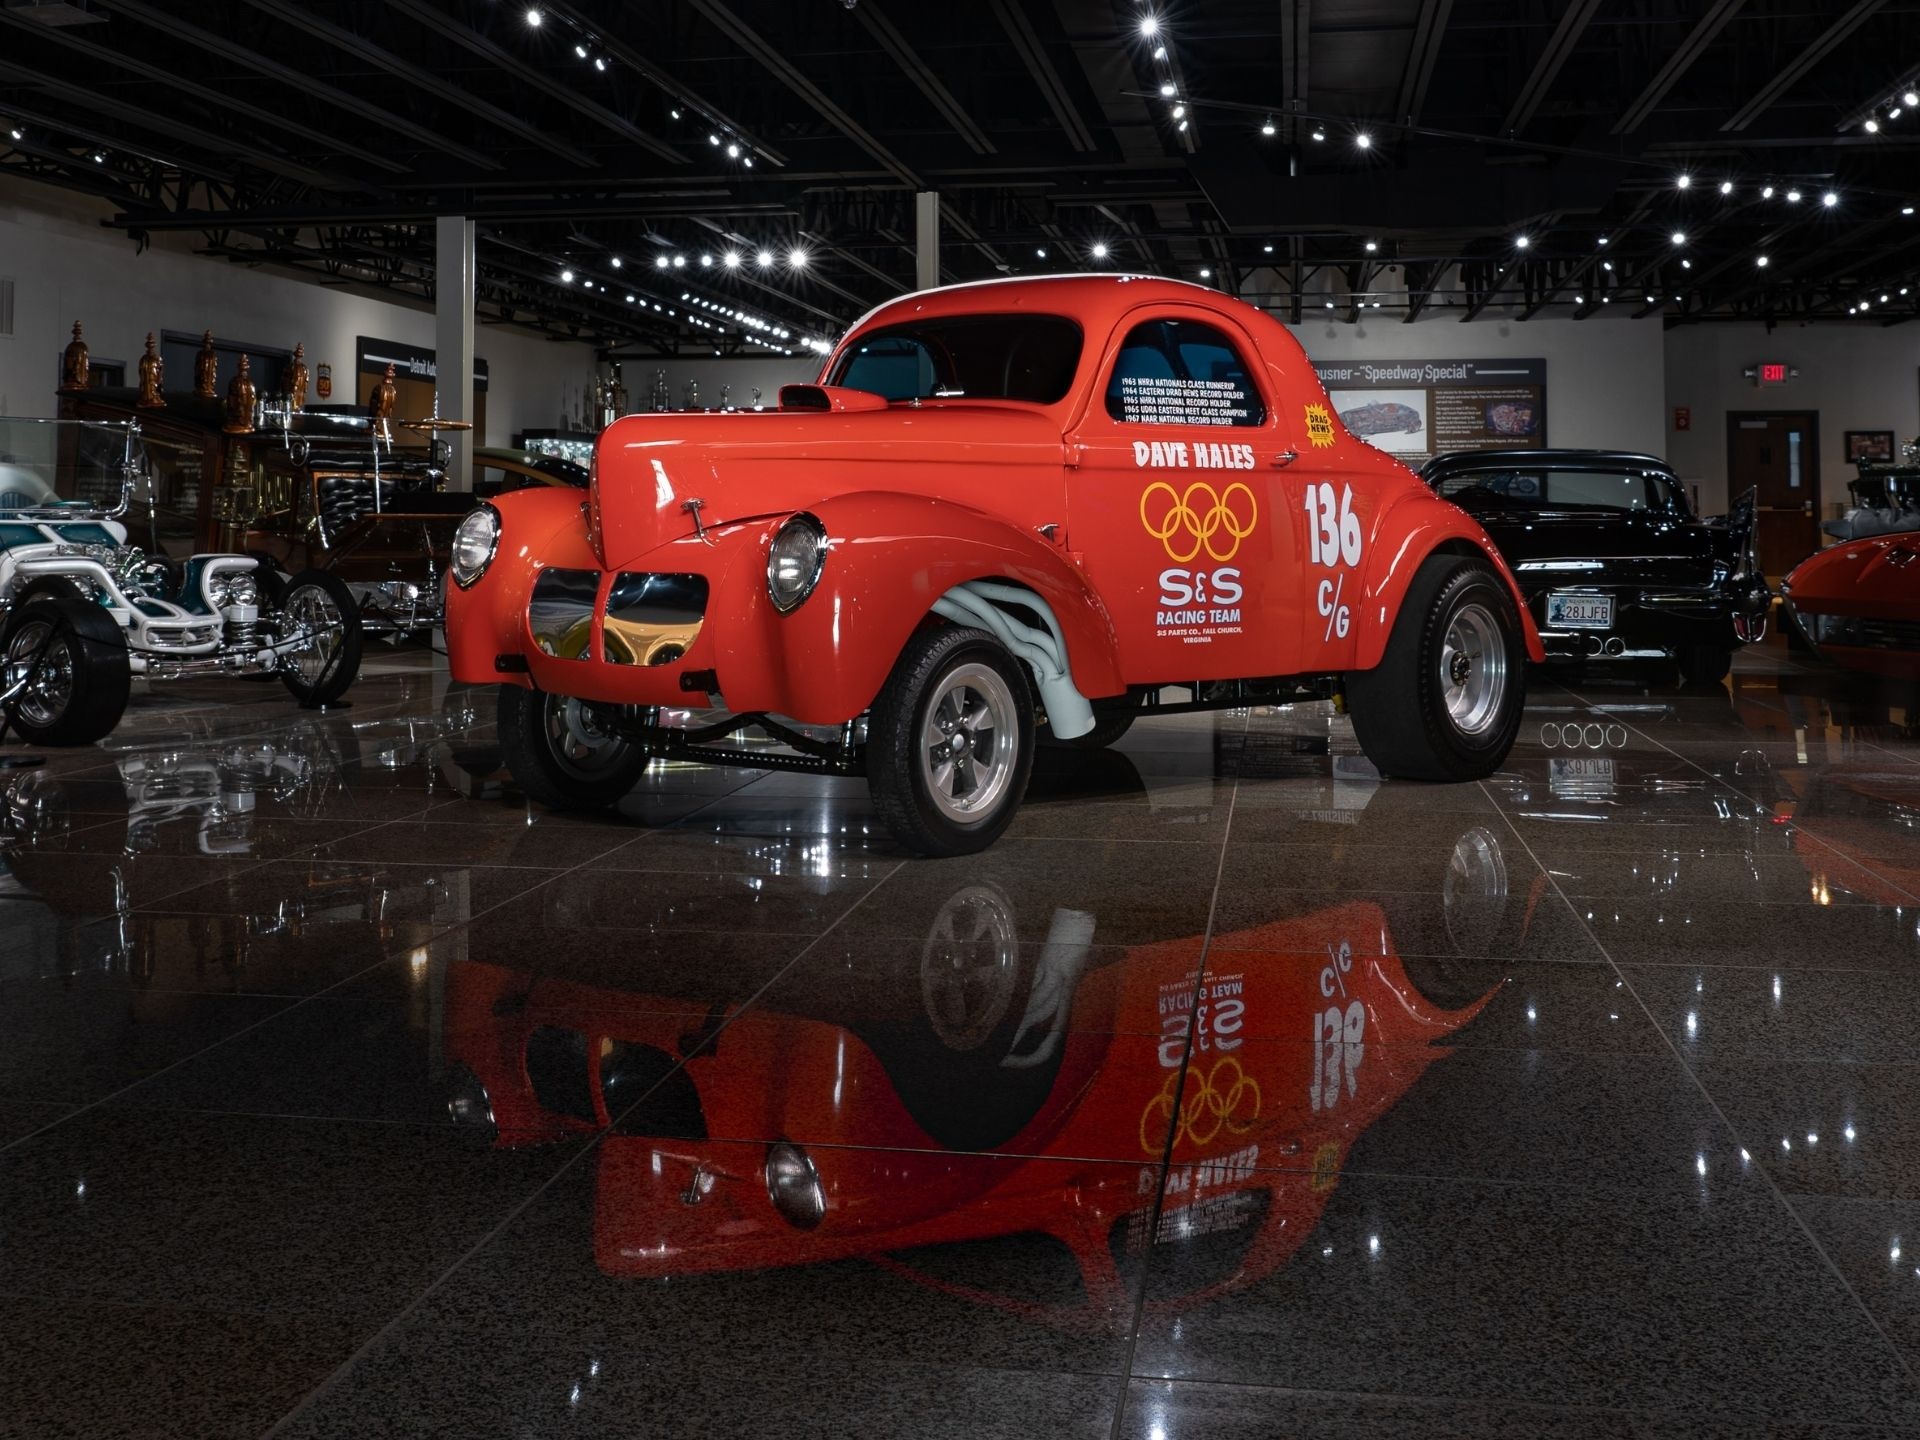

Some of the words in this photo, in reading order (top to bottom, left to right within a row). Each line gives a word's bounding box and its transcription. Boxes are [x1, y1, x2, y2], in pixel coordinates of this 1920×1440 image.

[411, 356, 427, 376] Detroit
[1763, 364, 1785, 382] EXIT
[1122, 377, 1136, 386] 1963
[1137, 378, 1154, 387] NHRA
[1155, 378, 1186, 388] NATIONALS
[1187, 380, 1205, 389] CLASS
[1206, 381, 1235, 390] RUNNERUP
[1122, 387, 1137, 395] 1964
[1138, 387, 1165, 396] EASTERN
[1166, 388, 1182, 397] DRAG
[1183, 389, 1199, 398] NEWS
[1200, 390, 1222, 398] RECORD
[1223, 391, 1244, 399] HOLDER
[1124, 396, 1138, 404] 1965
[1140, 396, 1156, 405] NHRA
[1157, 397, 1185, 406] NATIONAL
[1186, 398, 1209, 406] RECORD
[1210, 399, 1231, 407] HOLDER
[1125, 405, 1139, 413] 1965
[1140, 405, 1157, 414] UDRA
[1158, 406, 1184, 415] EASTERN
[1185, 407, 1200, 415] MEET
[1201, 408, 1218, 416] CLASS
[1219, 408, 1247, 417] CHAMPION
[1125, 414, 1139, 422] 1967
[1159, 415, 1187, 424] NATIONAL
[1188, 416, 1210, 425] RECORD
[1211, 417, 1233, 425] HOLDER
[1309, 414, 1328, 424] DRAG
[1310, 423, 1330, 433] NEWS
[1132, 441, 1189, 467] DAVE
[1192, 443, 1256, 470] HALES
[1304, 482, 1362, 568] 136
[1158, 567, 1243, 606] S&S
[1317, 573, 1350, 642] C/G
[1156, 610, 1206, 625] RACING
[1209, 608, 1241, 623] TEAM
[1168, 629, 1187, 637] PARTS
[1202, 627, 1216, 635] FALL
